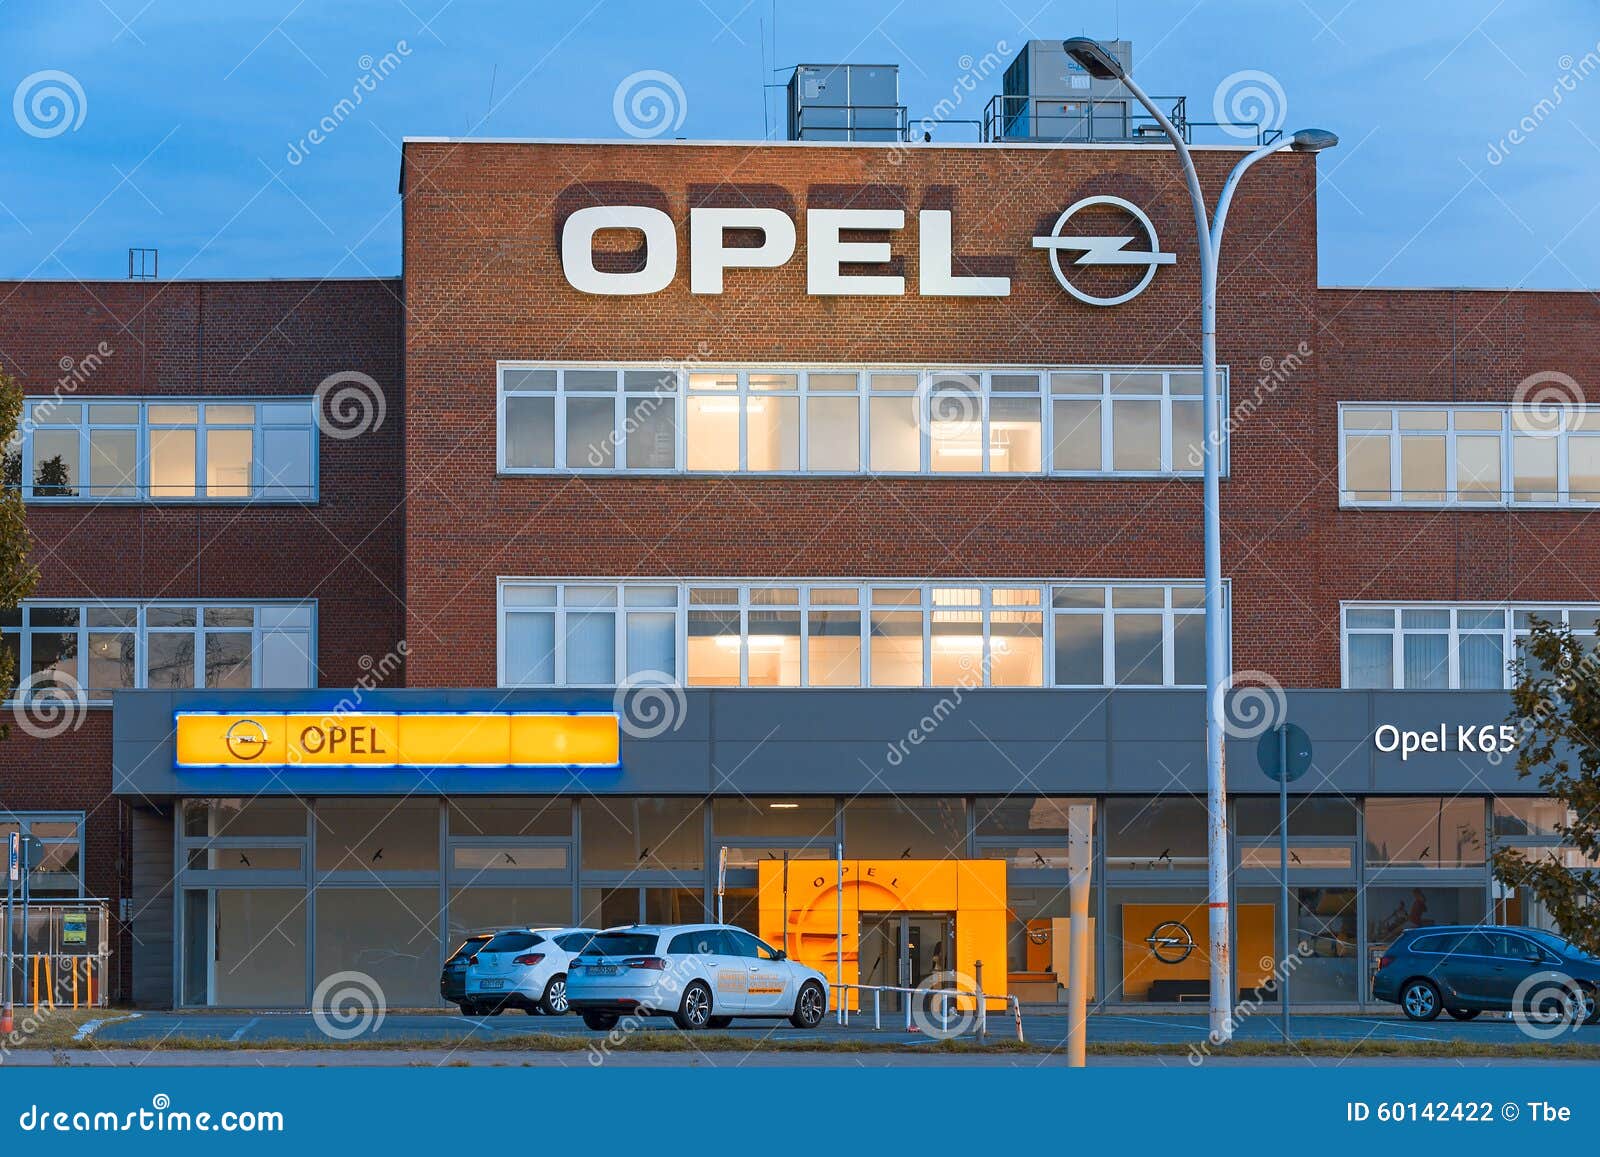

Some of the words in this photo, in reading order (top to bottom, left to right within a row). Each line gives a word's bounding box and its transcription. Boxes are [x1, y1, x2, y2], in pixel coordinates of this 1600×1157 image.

[562, 206, 1011, 295] OPEL
[301, 726, 386, 754] OPEL
[1375, 723, 1446, 761] Opel
[1458, 725, 1516, 753] K65
[813, 866, 899, 889] OPEL
